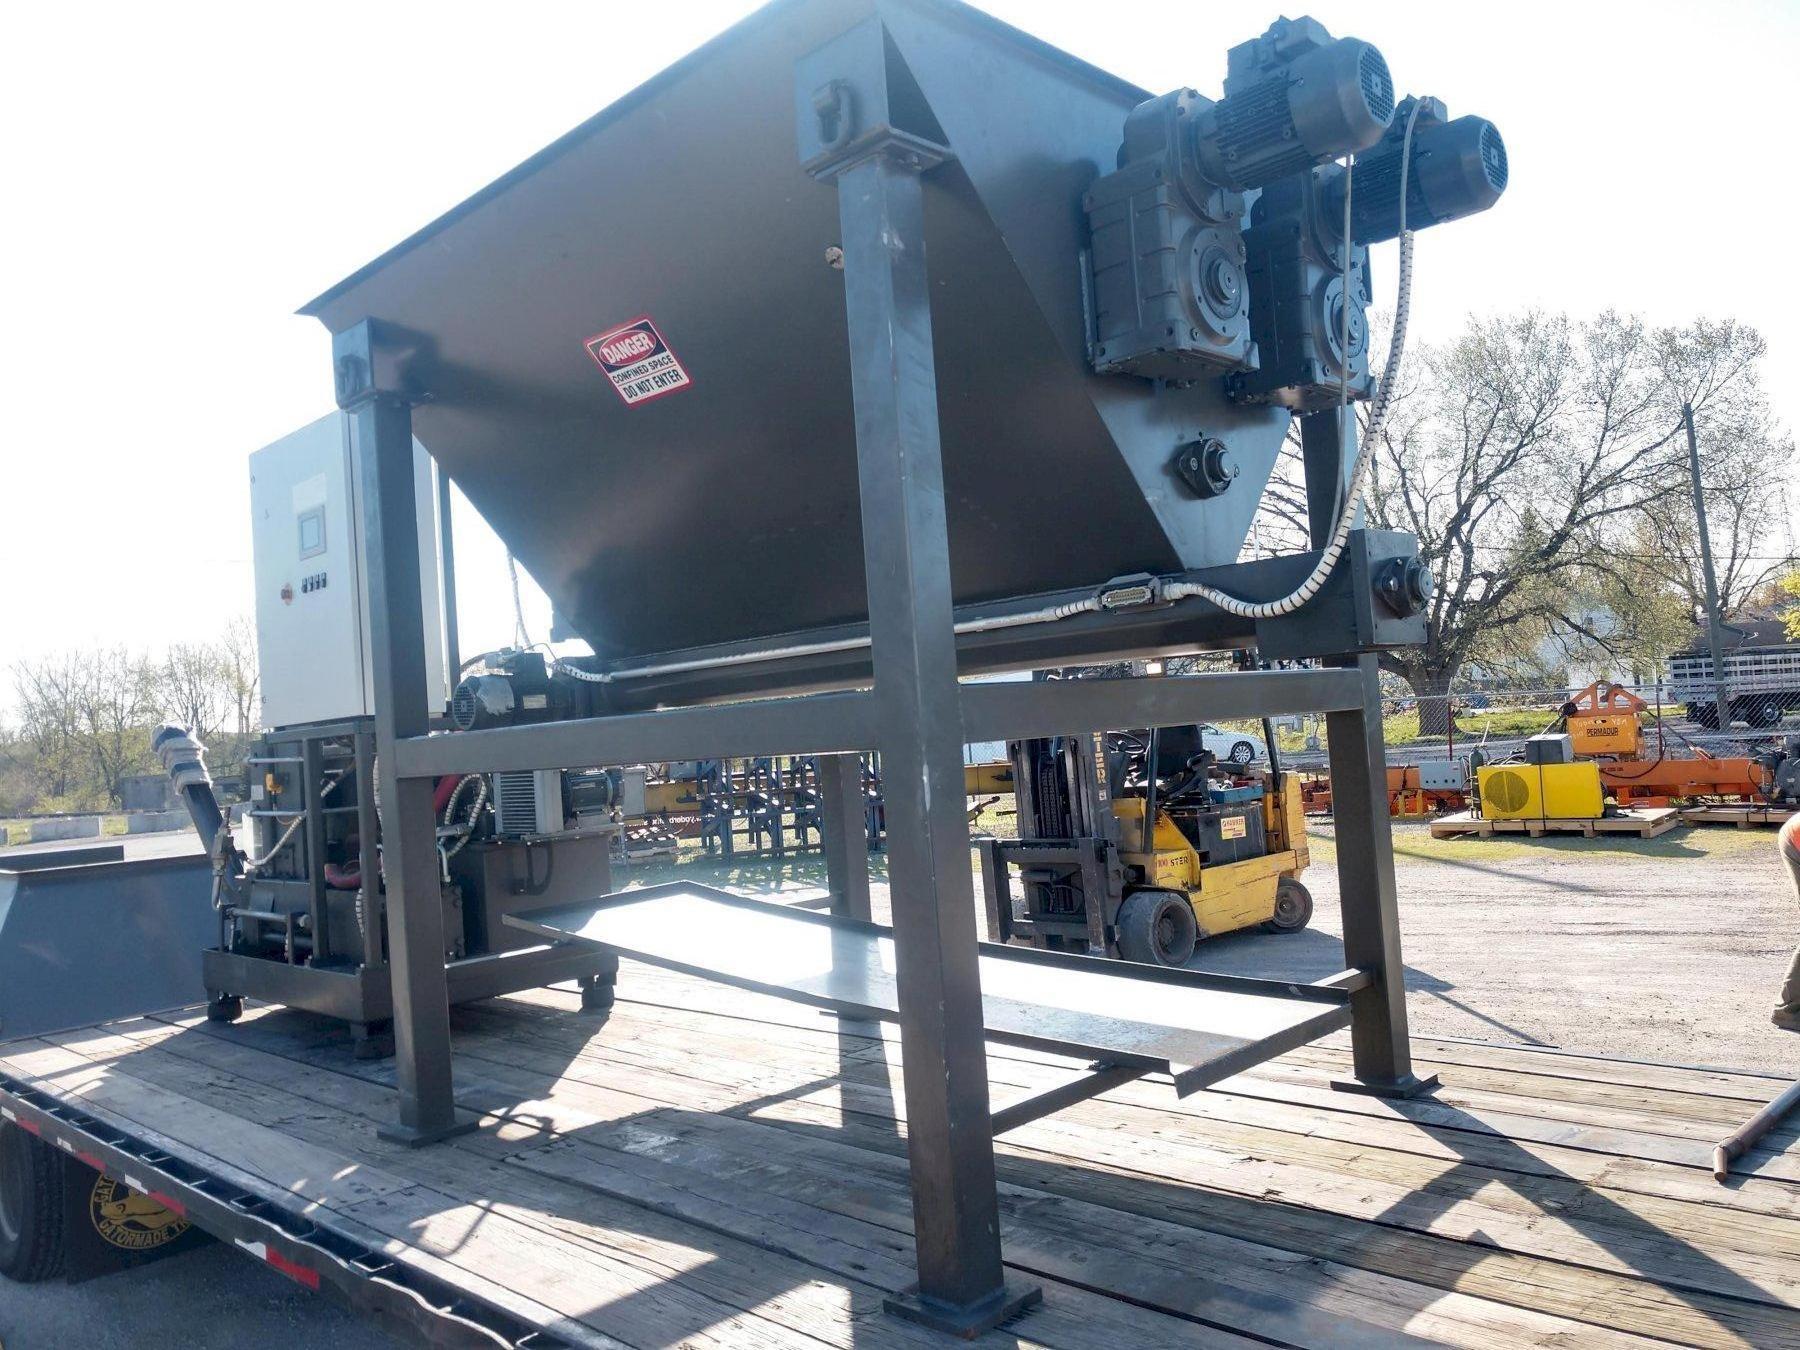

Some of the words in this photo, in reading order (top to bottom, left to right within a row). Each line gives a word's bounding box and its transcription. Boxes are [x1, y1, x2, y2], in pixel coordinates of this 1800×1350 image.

[601, 332, 654, 364] DANGER
[612, 365, 649, 384] CONFINED
[648, 355, 674, 371] SPACE
[623, 385, 638, 399] DO
[637, 378, 655, 395] NOT
[653, 369, 683, 389] ENTER
[1586, 727, 1619, 737] PERMADUR
[99, 1219, 172, 1248] GATORMADE
